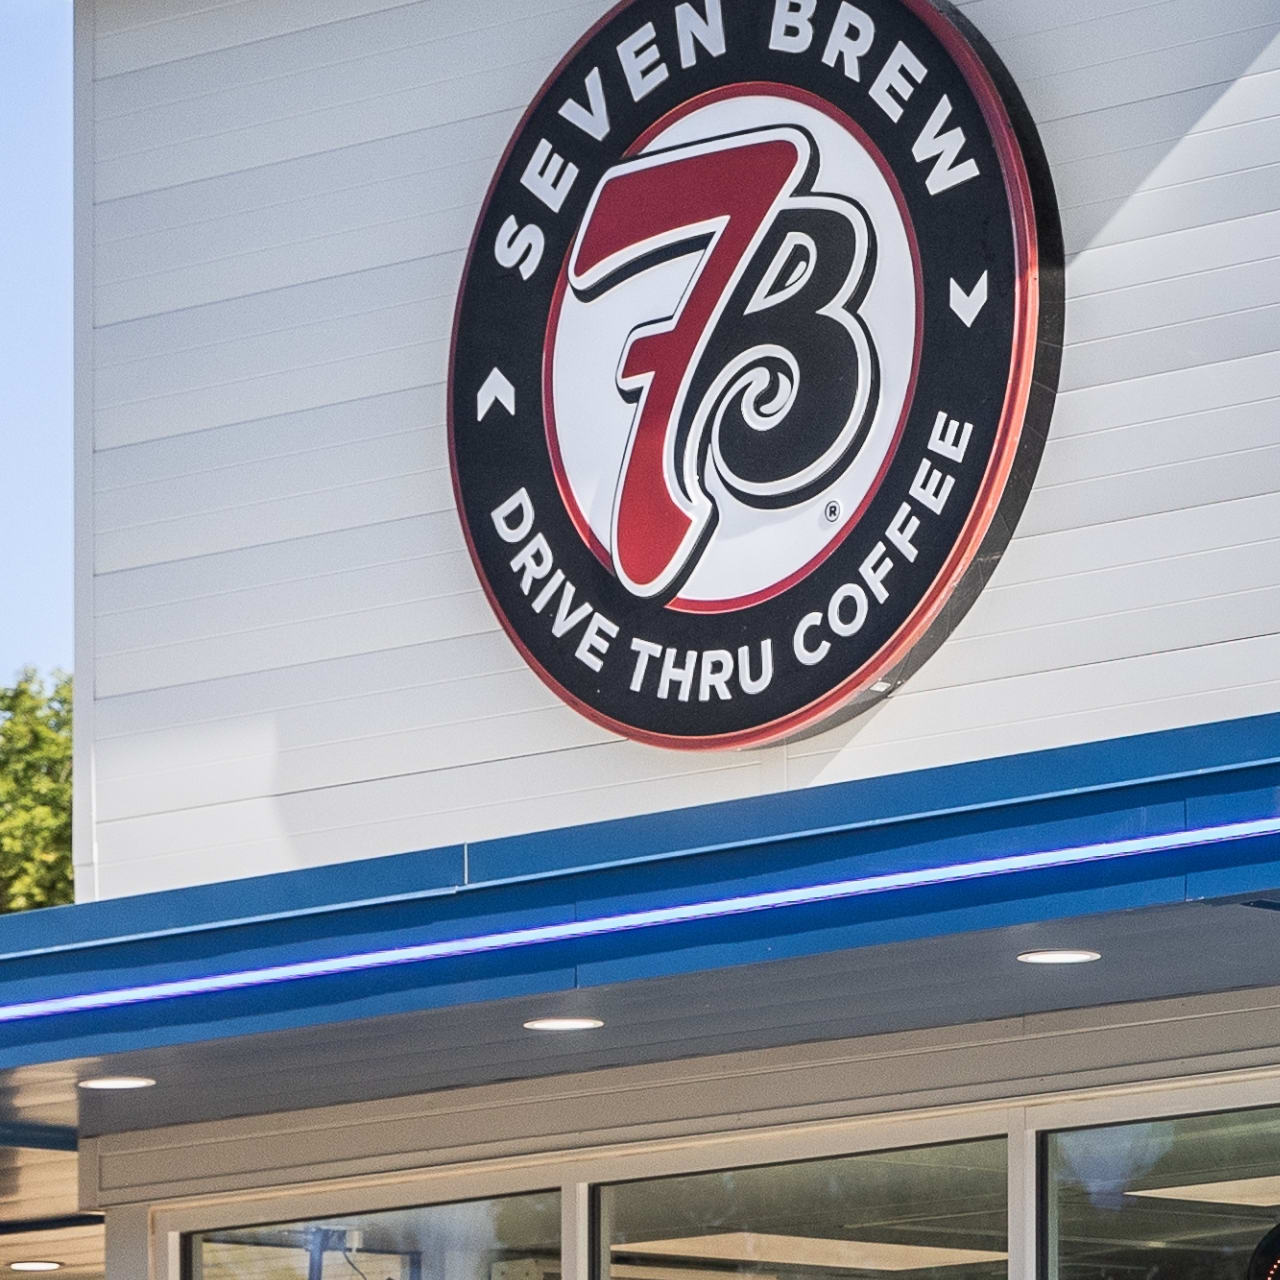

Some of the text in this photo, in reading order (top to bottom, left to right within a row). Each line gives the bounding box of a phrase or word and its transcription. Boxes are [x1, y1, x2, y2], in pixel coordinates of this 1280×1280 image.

[490, 409, 973, 703] DRIVE THRU COFFEE
